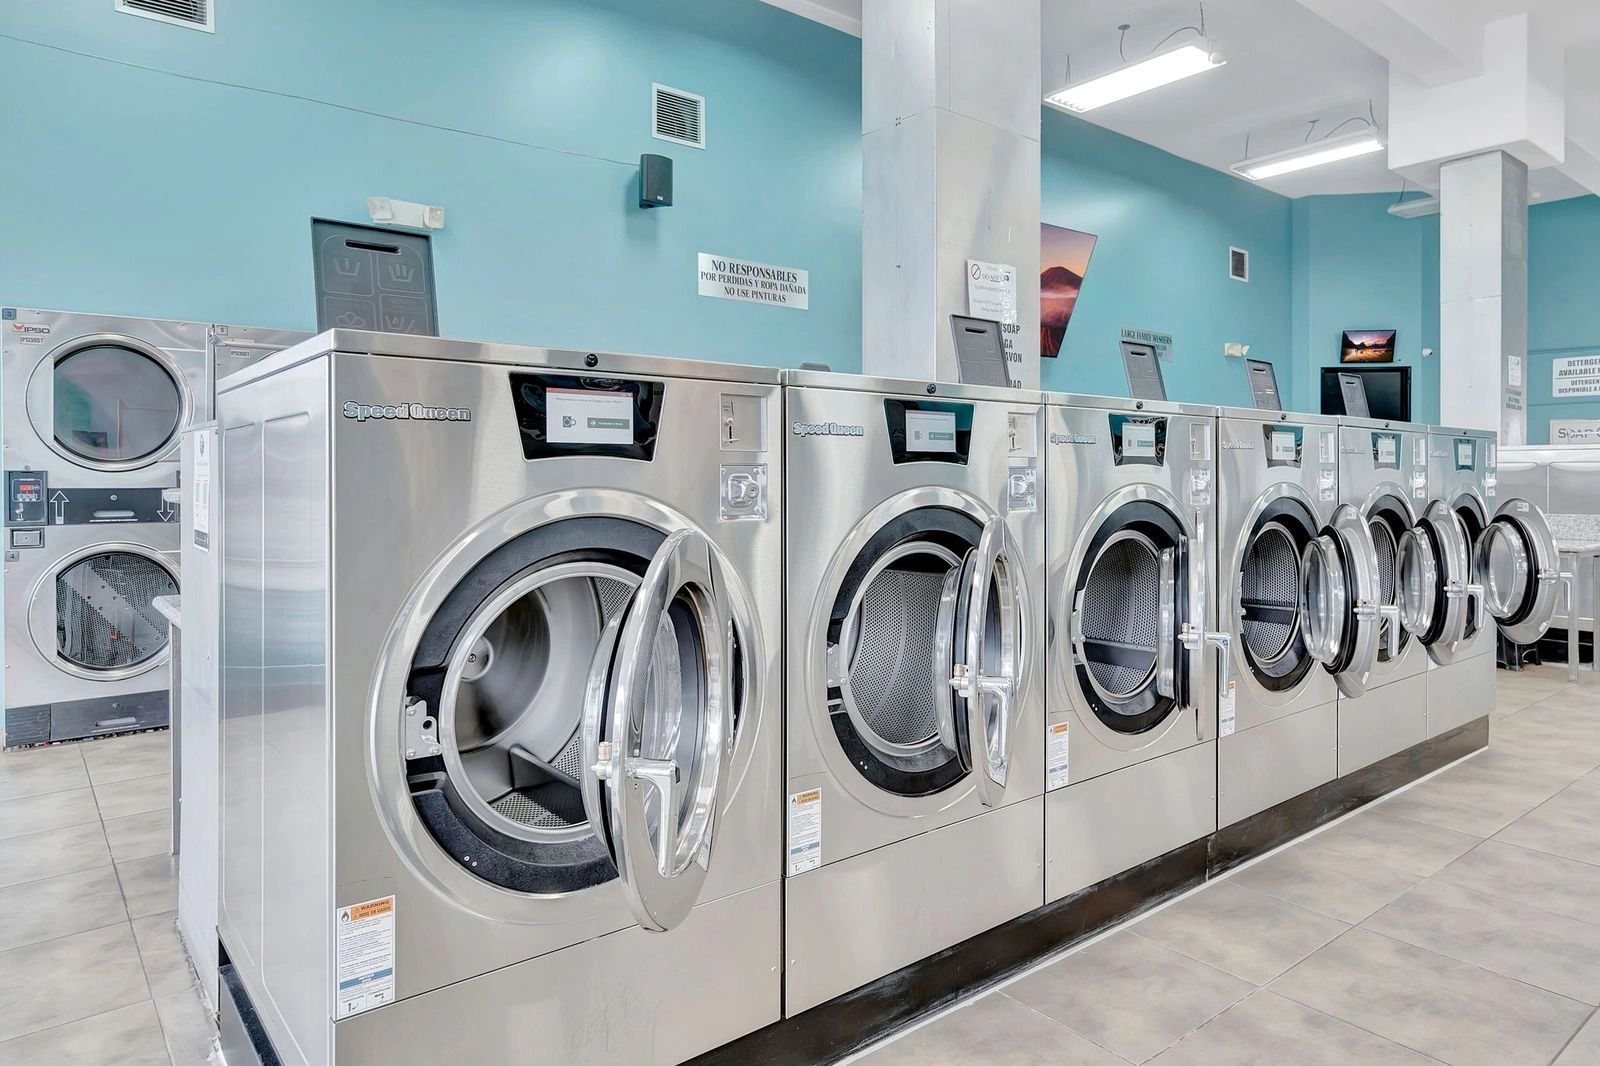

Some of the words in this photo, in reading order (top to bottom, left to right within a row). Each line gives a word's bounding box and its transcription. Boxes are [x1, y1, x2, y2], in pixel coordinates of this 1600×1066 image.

[711, 259, 726, 272] NO
[729, 262, 798, 283] RESPONSABLES
[700, 271, 716, 281] POR
[718, 275, 753, 287] PERDIDAS
[755, 279, 760, 287] Y
[761, 280, 778, 290] ROPA
[779, 282, 806, 295] DAÑADA
[724, 286, 735, 296] NO
[737, 288, 750, 298] USE
[751, 291, 787, 303] PINTURAS
[24, 326, 50, 334] IPSO
[1558, 367, 1596, 377] AVAILABLE
[1558, 386, 1592, 394] DISPONIBLE
[343, 401, 409, 421] Speed
[409, 403, 471, 421] Queen
[793, 421, 829, 437] Speed
[829, 423, 864, 437] Queen
[361, 899, 390, 910] WARNING
